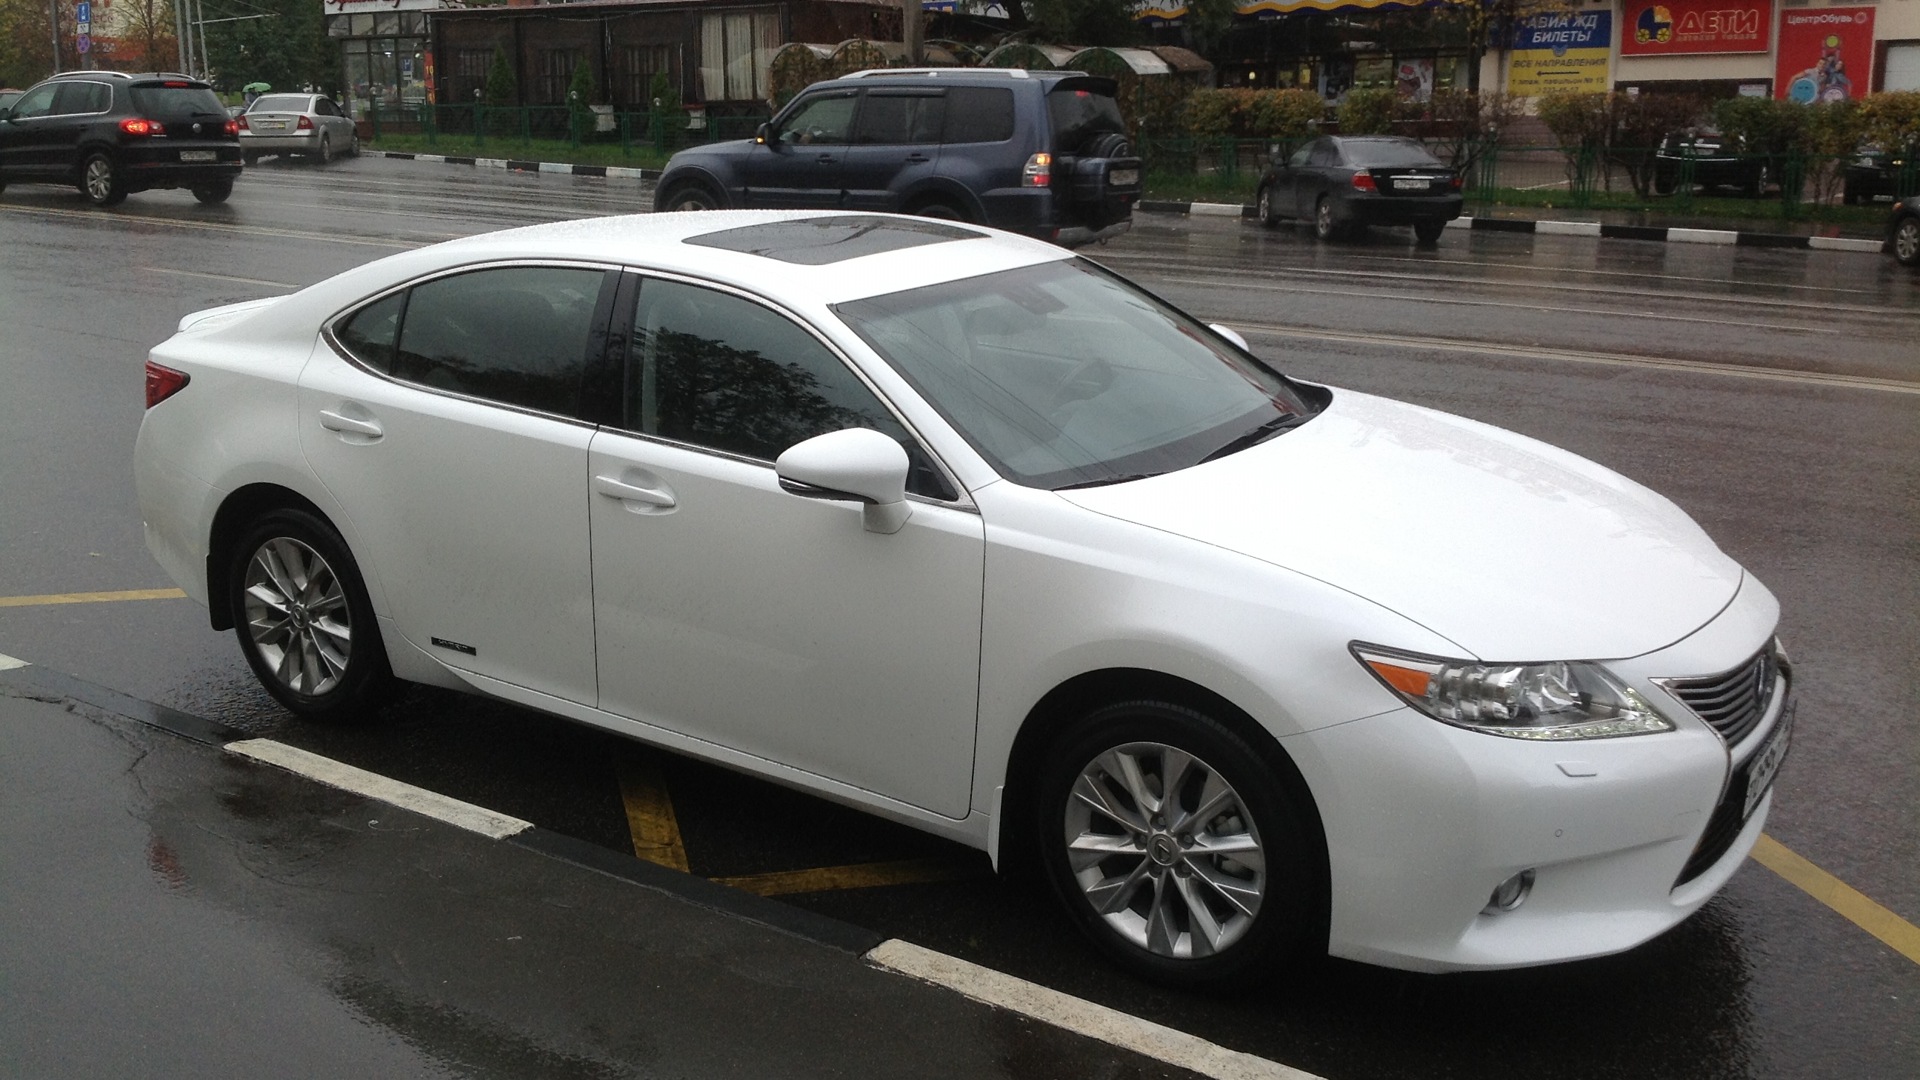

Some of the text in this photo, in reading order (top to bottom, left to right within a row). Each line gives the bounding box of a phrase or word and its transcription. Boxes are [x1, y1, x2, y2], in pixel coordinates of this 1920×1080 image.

[1527, 15, 1598, 29] АВИА ЖД
[1676, 9, 1759, 34] ДЕТИ
[1787, 14, 1852, 25] ЦентрОбувь
[1532, 31, 1591, 42] БИЛЕТЫ
[1513, 58, 1606, 68] ВСЕ НАПРАВЛЕНИЯ
